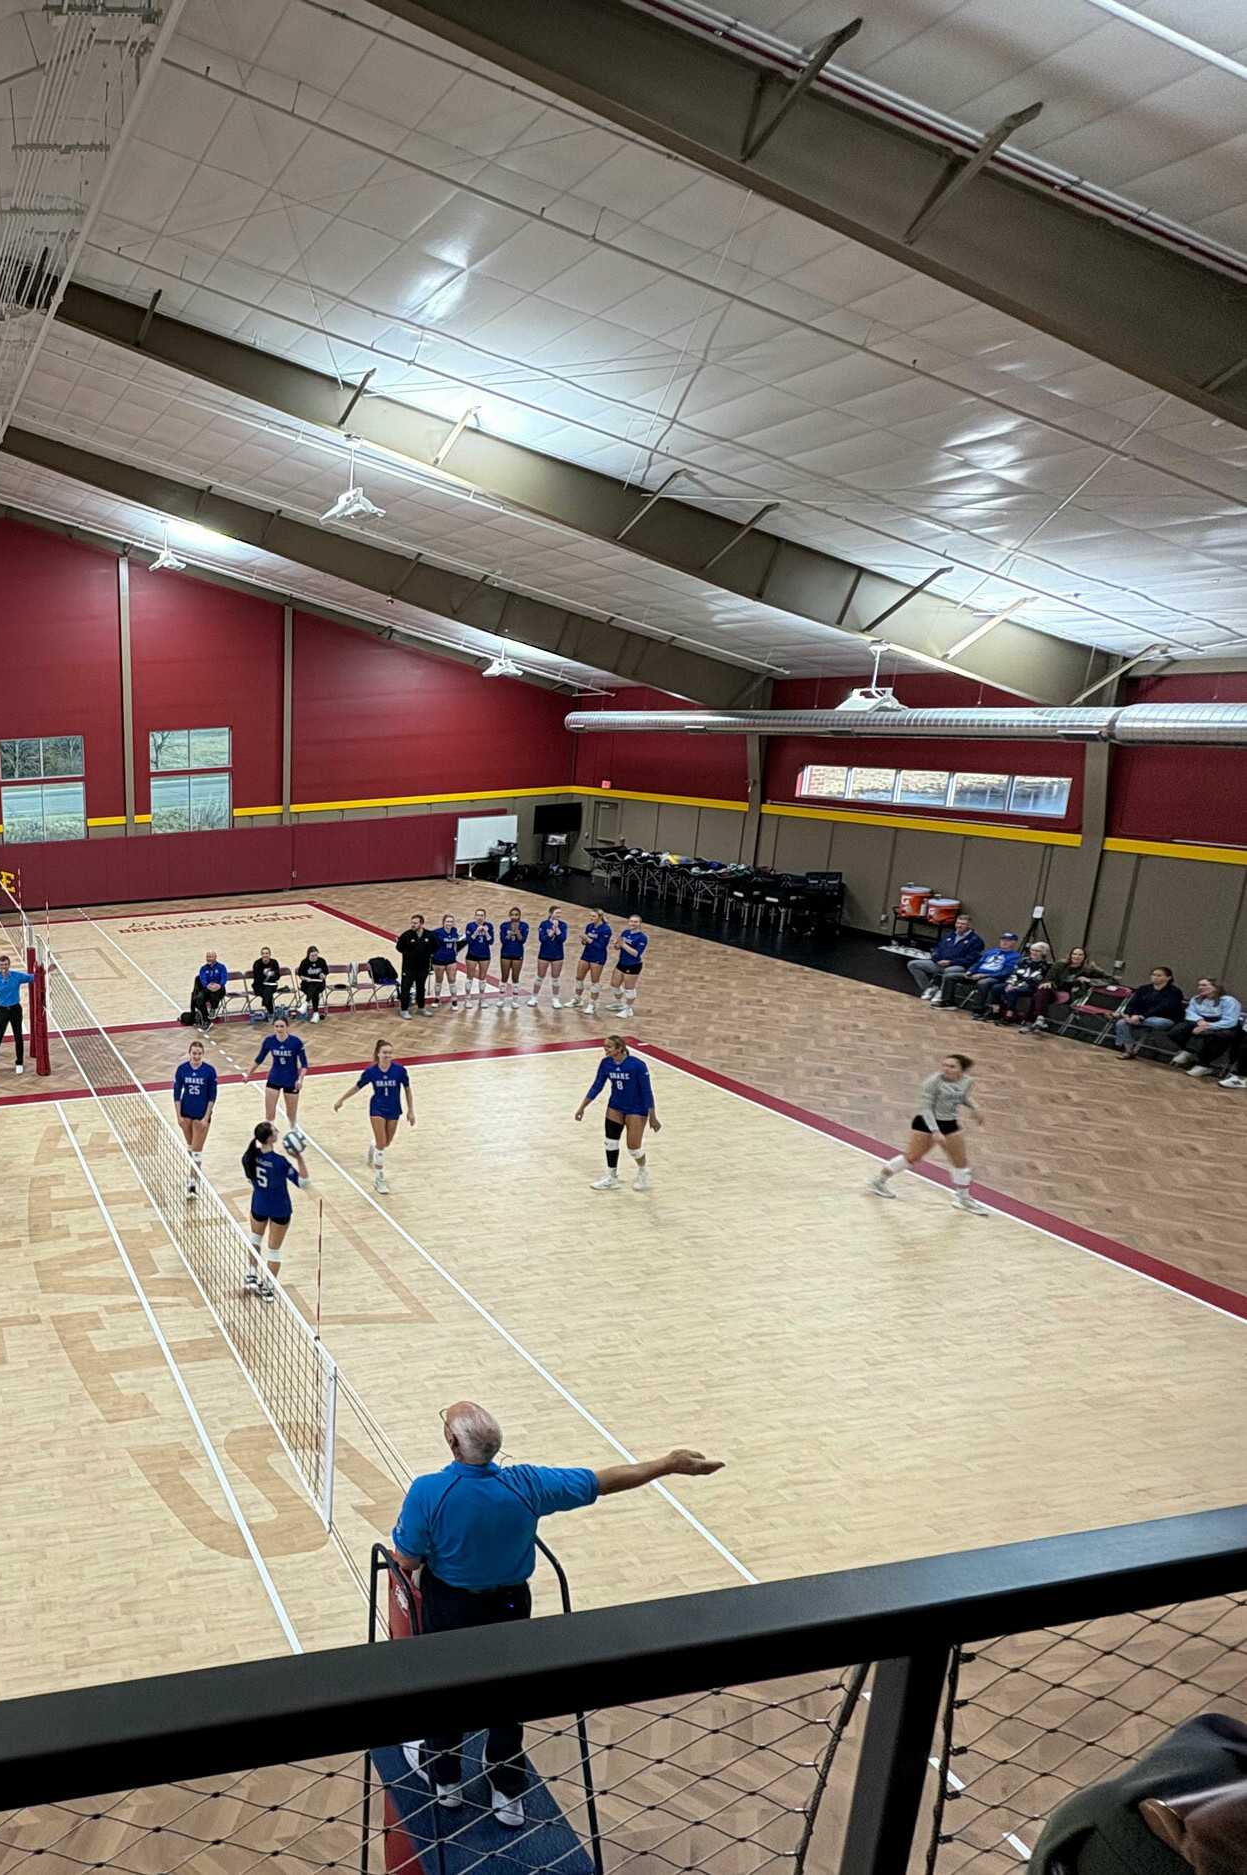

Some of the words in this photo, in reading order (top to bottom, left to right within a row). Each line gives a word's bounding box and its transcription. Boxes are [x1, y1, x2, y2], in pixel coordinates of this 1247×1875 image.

[188, 1085, 200, 1095] 25
[616, 1080, 624, 1090] 8
[256, 1166, 268, 1188] 5
